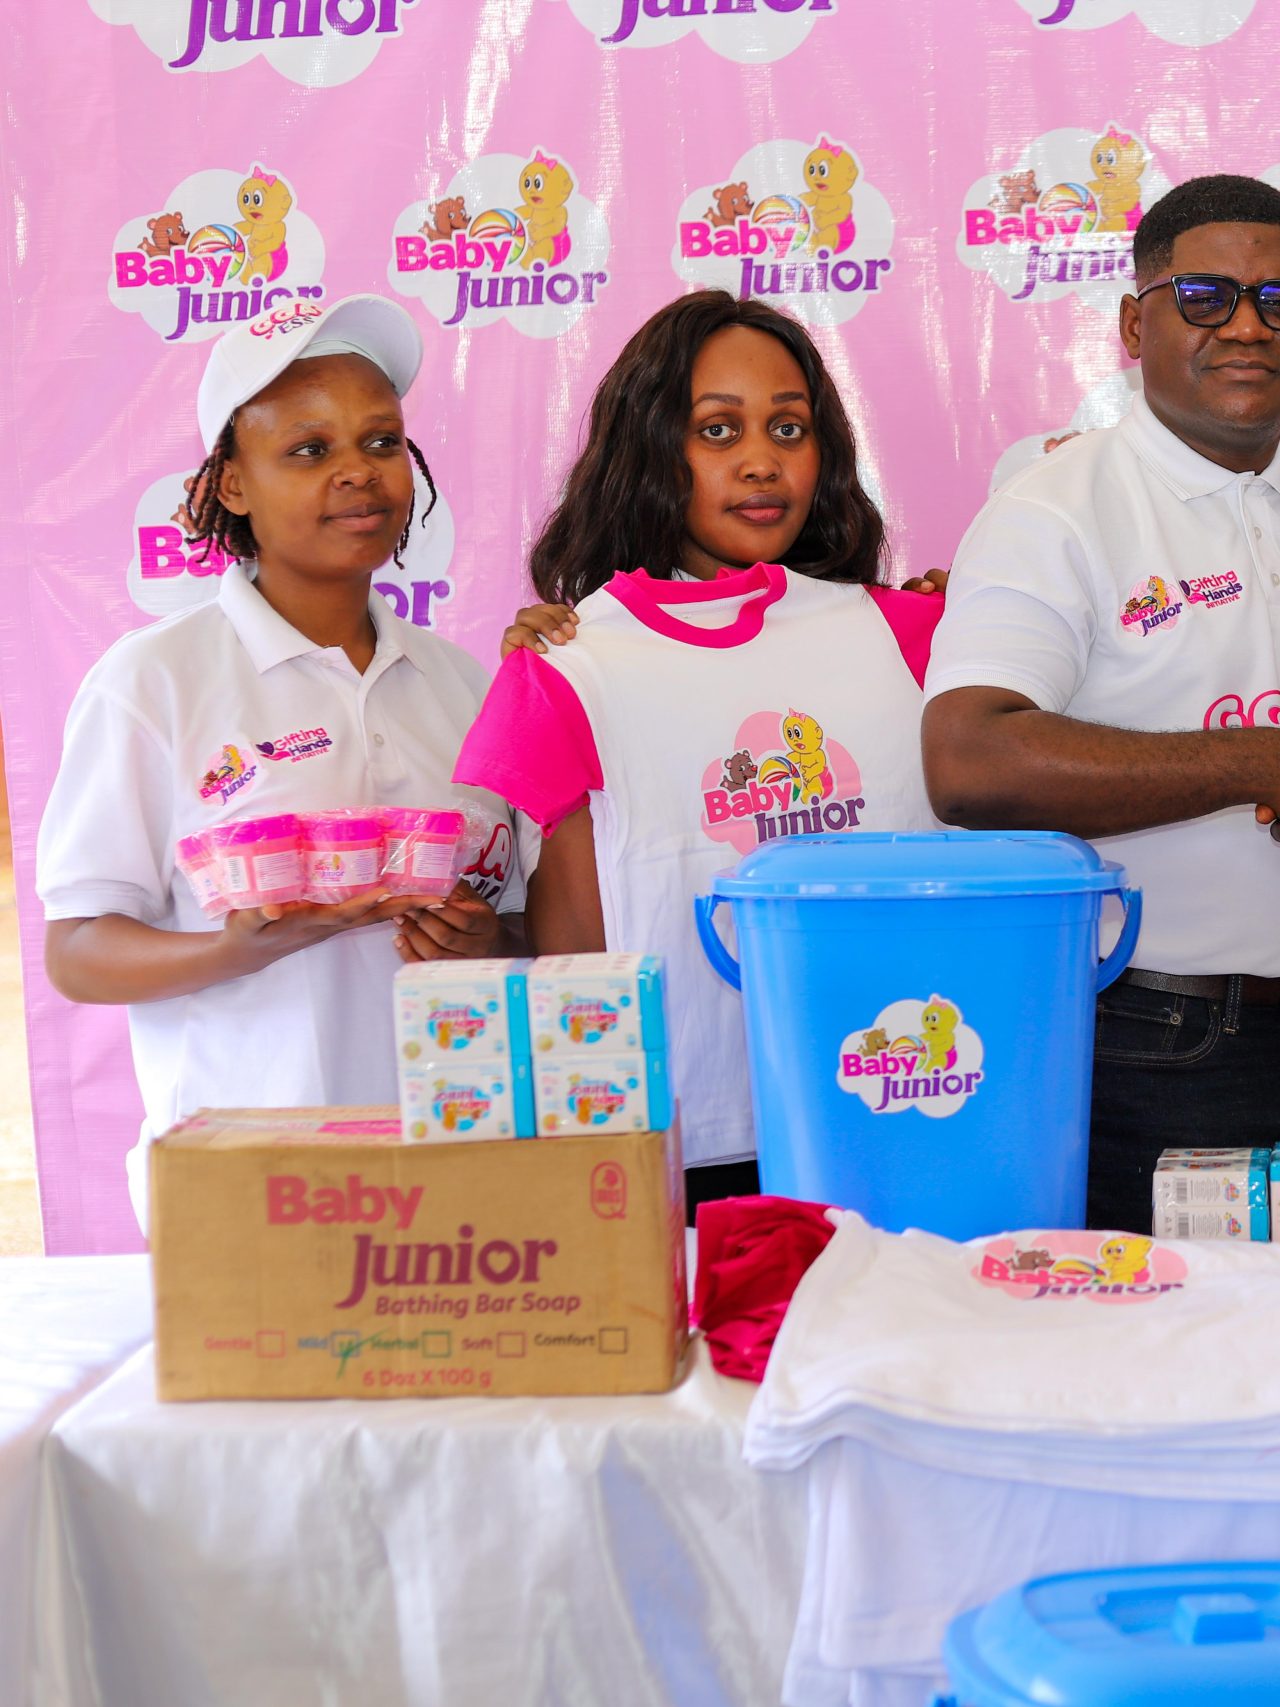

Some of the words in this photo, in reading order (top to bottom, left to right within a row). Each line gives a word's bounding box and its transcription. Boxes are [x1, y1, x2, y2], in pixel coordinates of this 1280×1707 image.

[680, 219, 796, 259] Baby
[966, 207, 1084, 248] Baby
[115, 249, 232, 288] Baby
[395, 233, 513, 272] Baby
[442, 262, 607, 326] Junior
[1189, 570, 1238, 593] Gifting
[1204, 580, 1243, 603] Hands
[1119, 604, 1156, 626] Baby
[1141, 602, 1183, 637] Junior
[1205, 594, 1241, 610] INITIATIVE
[273, 727, 328, 751] Gifting
[288, 736, 333, 757] Hands
[220, 765, 257, 806] Junior
[704, 778, 795, 825] Baby
[754, 796, 866, 844] Junior
[843, 1051, 920, 1078] Baby
[873, 1069, 981, 1111] Junior
[266, 1174, 425, 1228] Baby
[335, 1224, 558, 1309] Junior
[375, 1293, 470, 1319] Bathing
[475, 1293, 516, 1315] Bar
[521, 1292, 582, 1315] Soap
[462, 1337, 494, 1350] Soft
[533, 1333, 596, 1347] Comfort
[379, 1369, 416, 1387] Doz
[438, 1367, 475, 1386] 100
[479, 1371, 493, 1388] g
